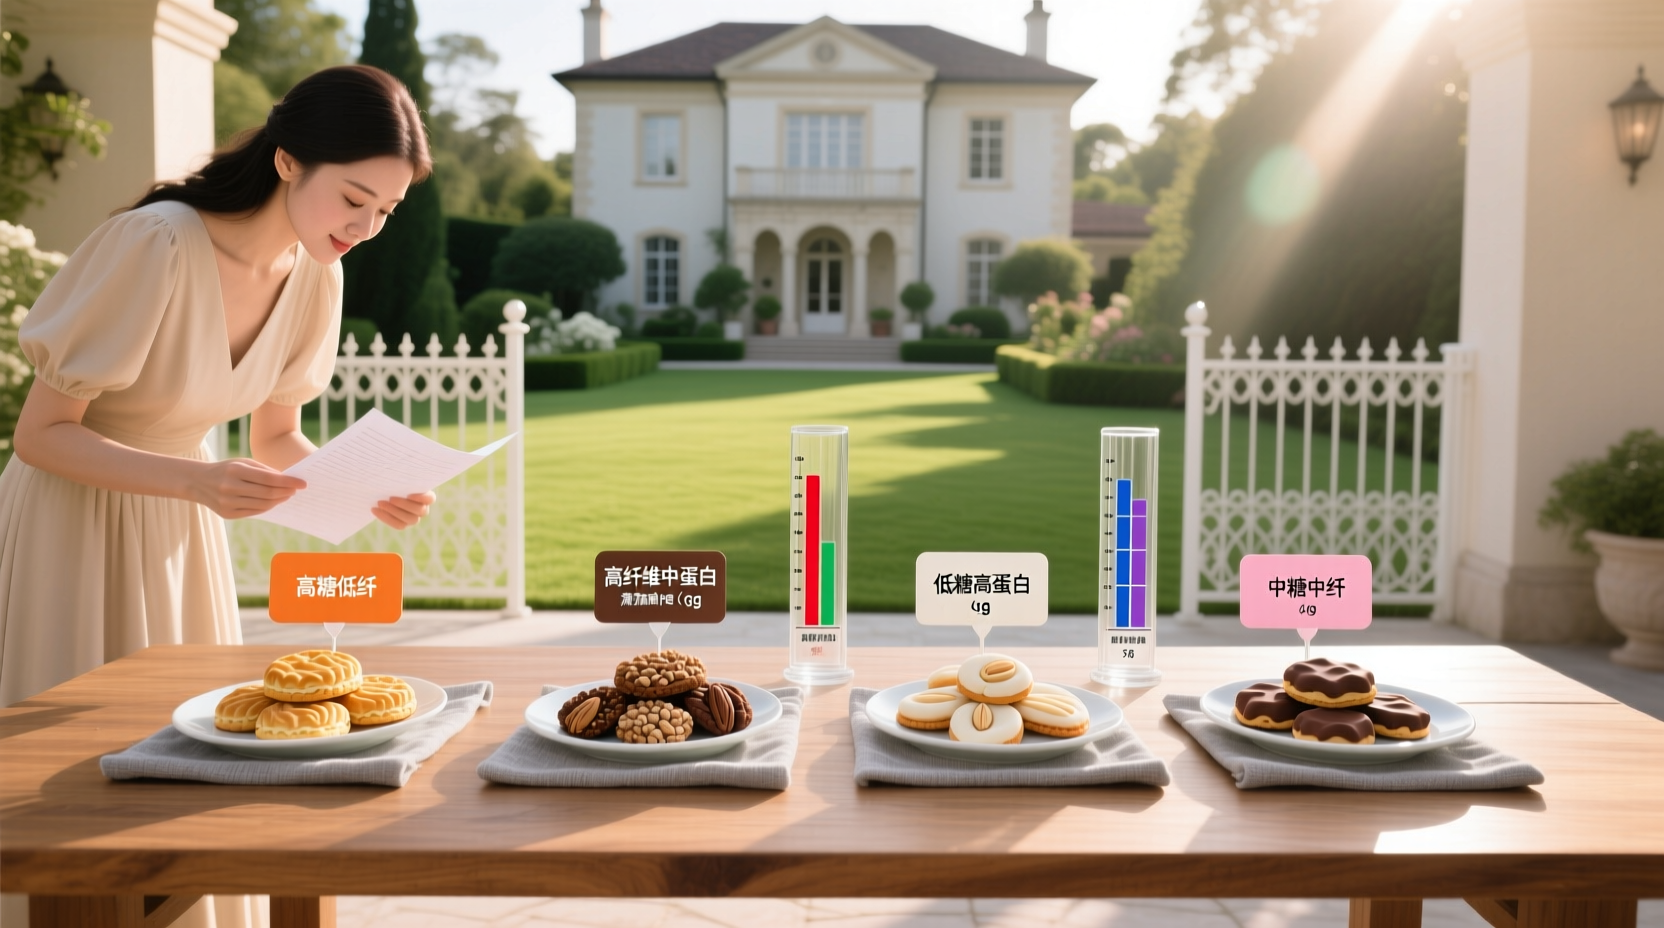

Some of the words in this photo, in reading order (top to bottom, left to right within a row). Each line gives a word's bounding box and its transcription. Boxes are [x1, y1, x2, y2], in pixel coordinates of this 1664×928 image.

[296, 574, 377, 598] 高糖低纤
[604, 565, 716, 587] 高纤维中蛋白
[933, 573, 1030, 595] 低糖高蛋白
[1269, 576, 1345, 598] 中糖中纤
